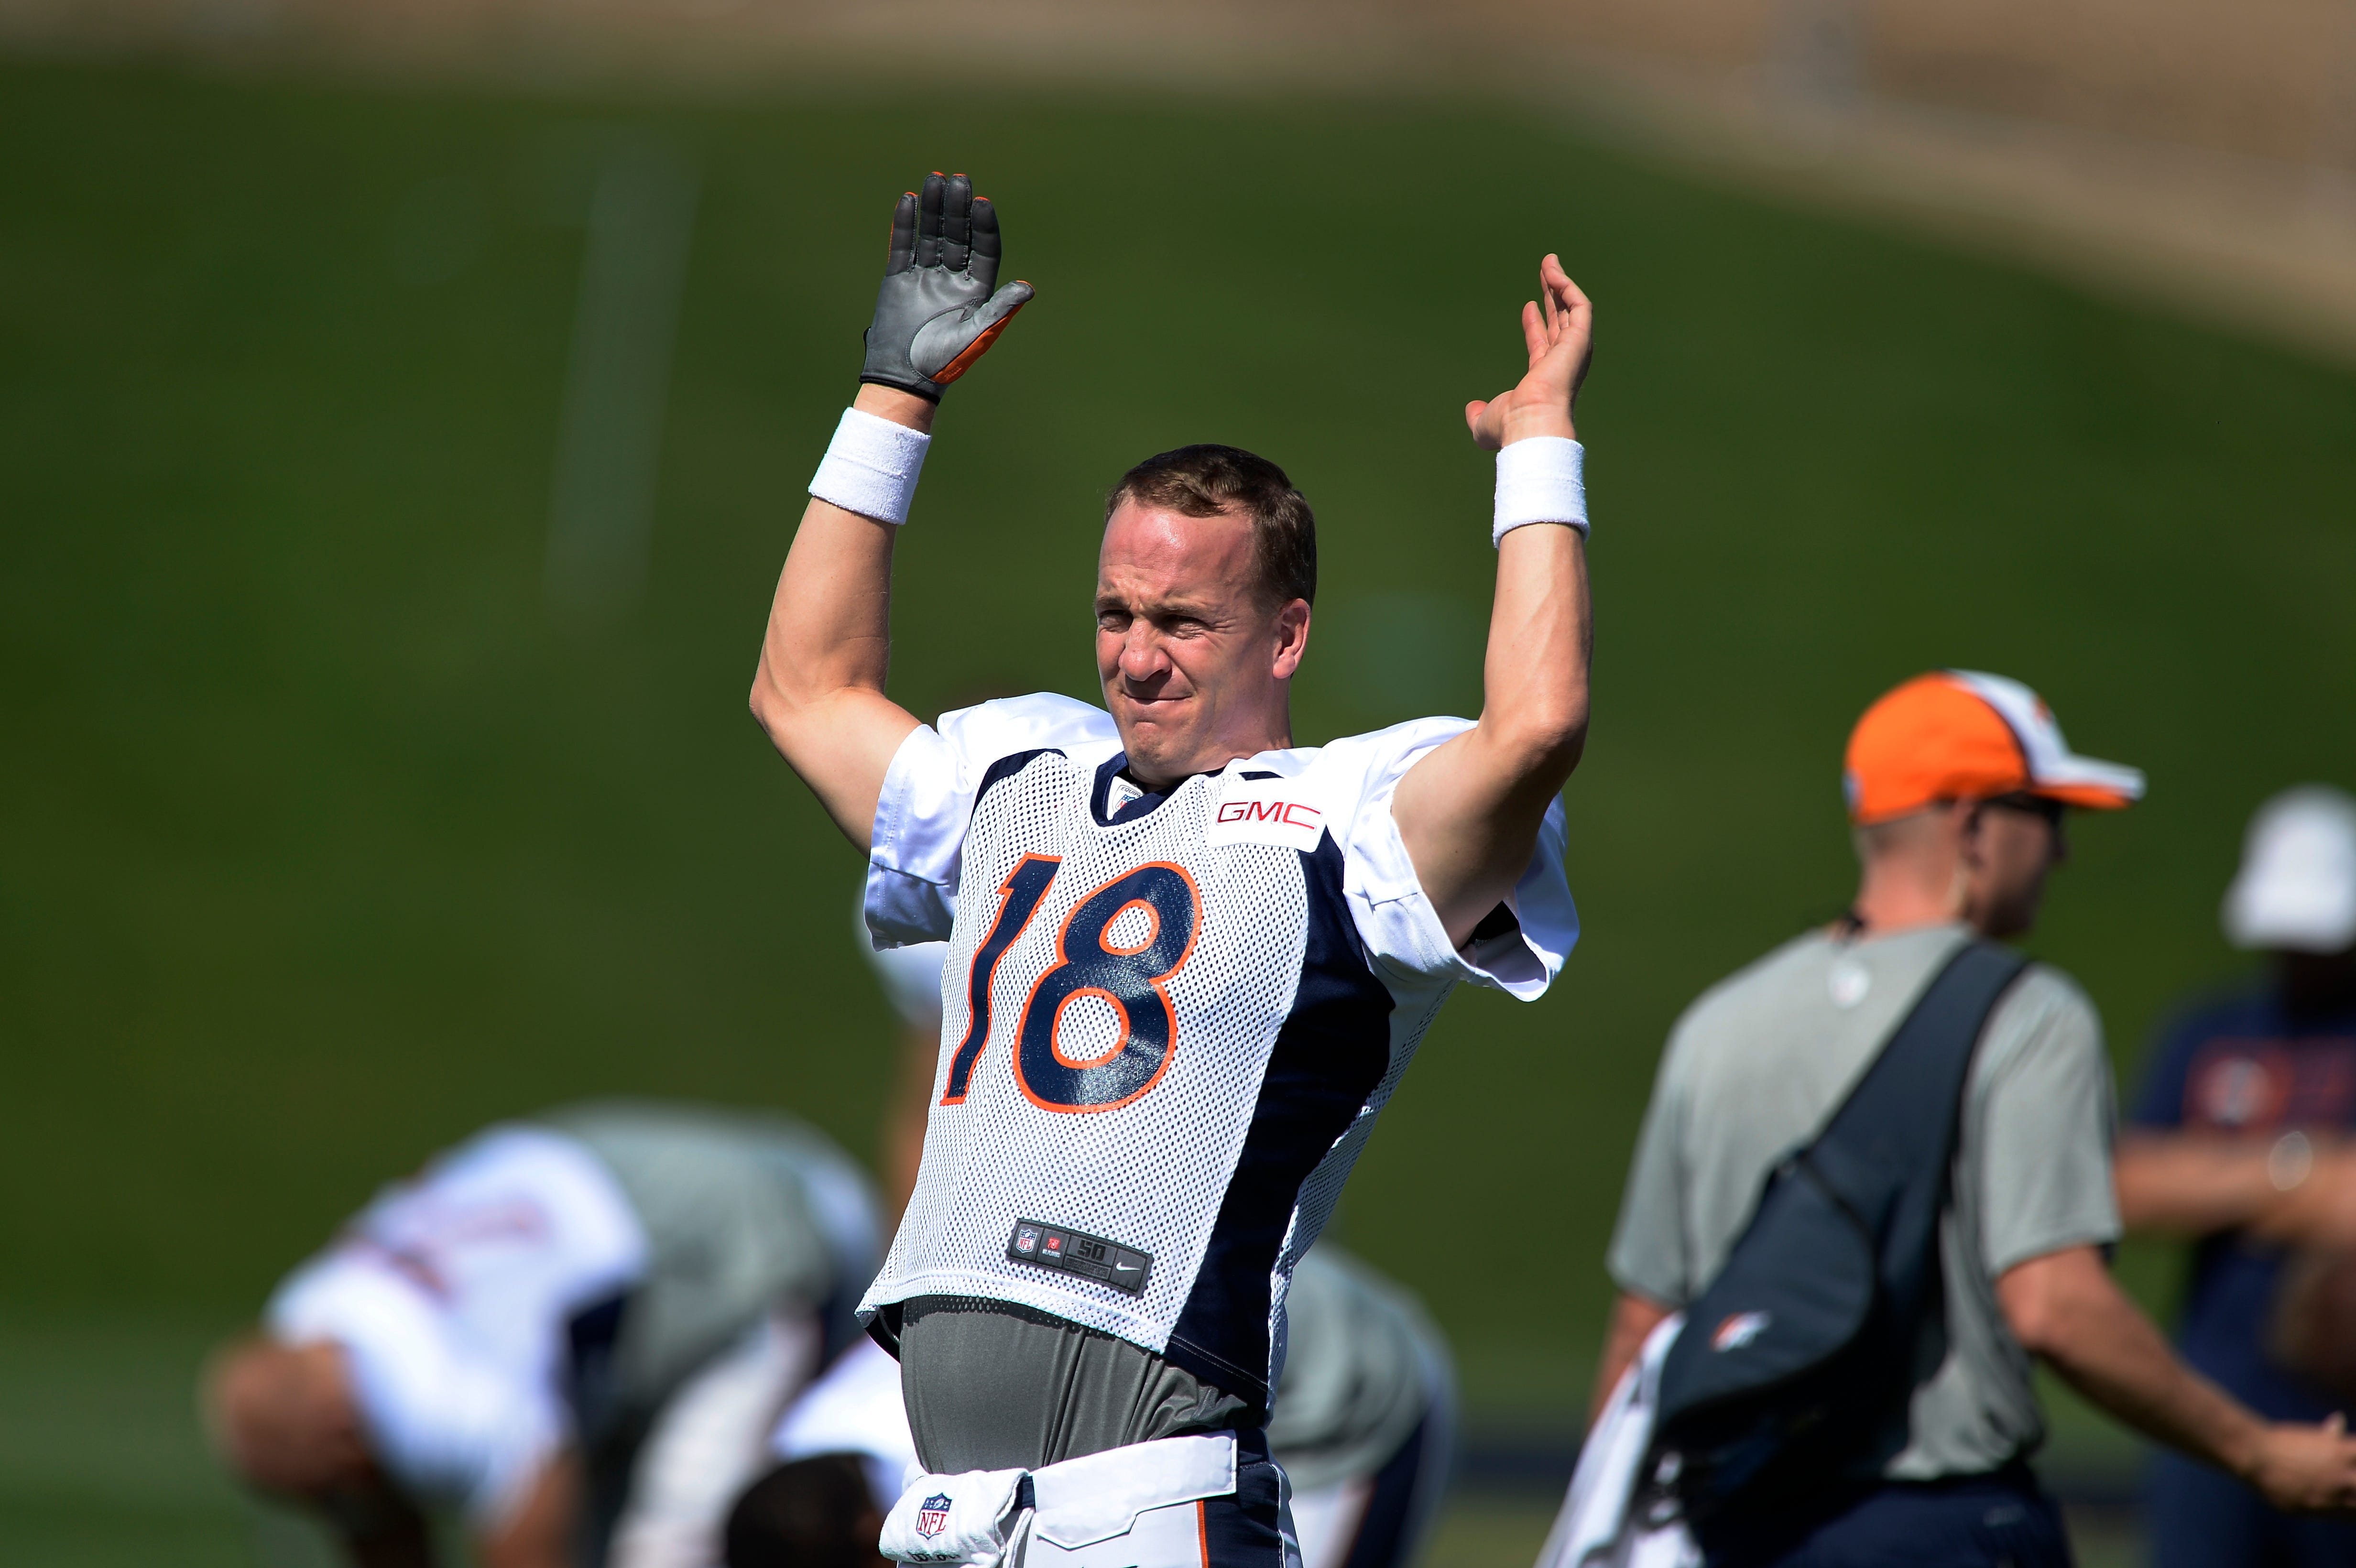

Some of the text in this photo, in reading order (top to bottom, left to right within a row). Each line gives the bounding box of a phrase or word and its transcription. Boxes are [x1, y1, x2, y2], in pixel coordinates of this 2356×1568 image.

[1217, 801, 1321, 829] GMC
[940, 852, 1202, 1114] 18
[1018, 1239, 1031, 1249] NFL
[1077, 1240, 1106, 1262] 50
[918, 1512, 947, 1535] NFL
